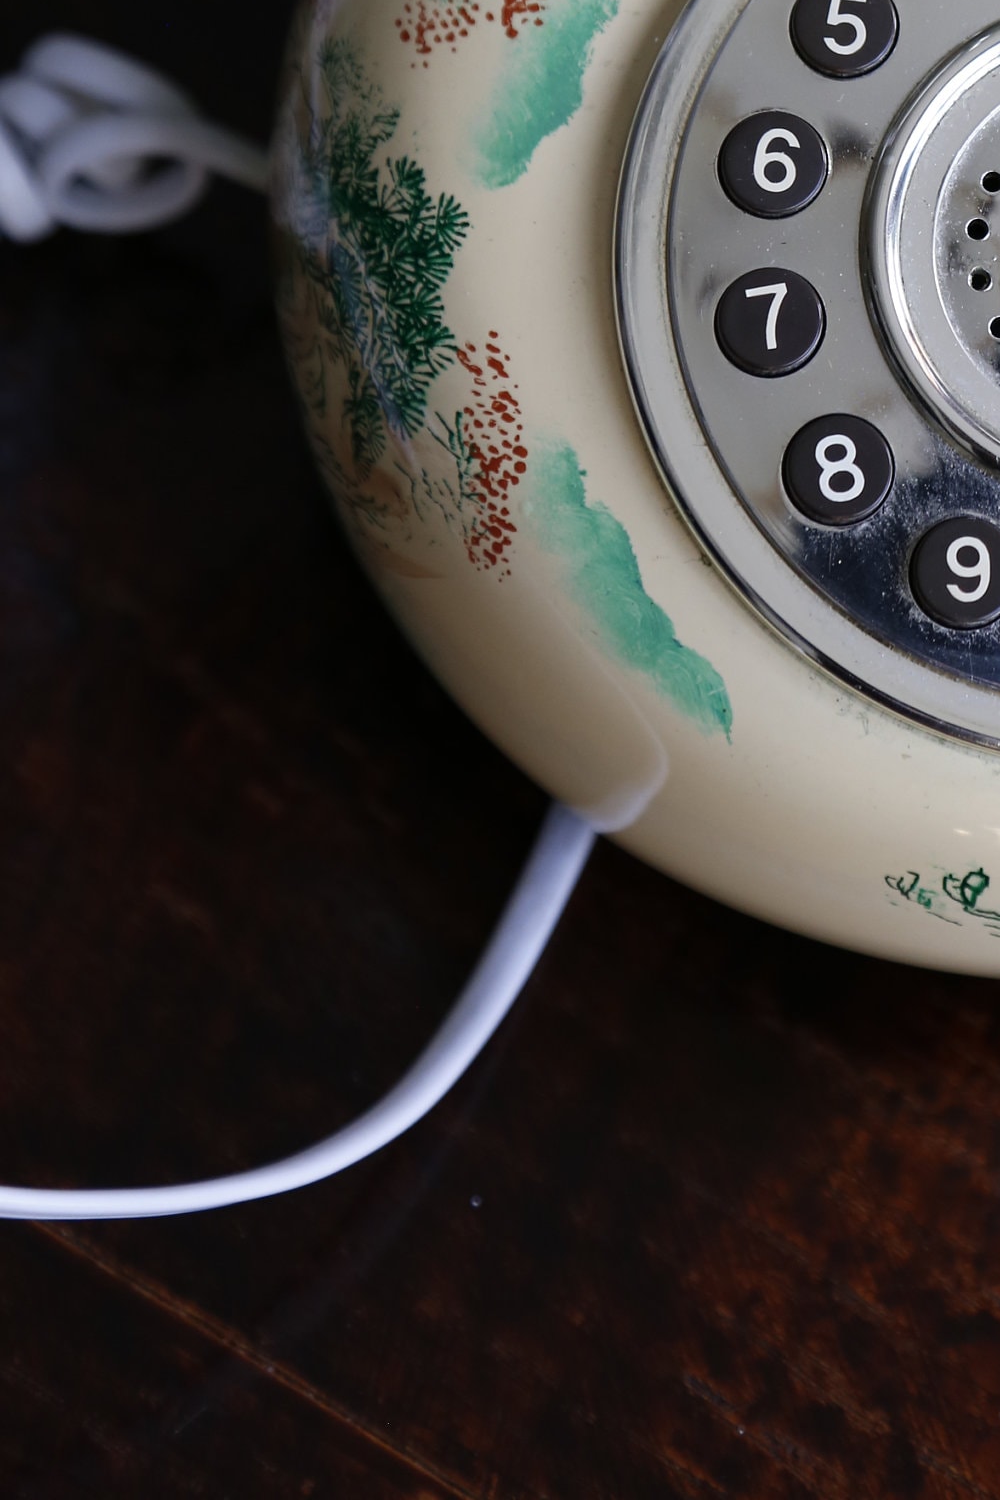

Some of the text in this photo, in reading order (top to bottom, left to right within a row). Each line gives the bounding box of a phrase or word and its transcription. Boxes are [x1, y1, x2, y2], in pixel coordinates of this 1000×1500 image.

[753, 128, 801, 193] 6
[744, 282, 788, 350] 7
[814, 434, 865, 503] 8
[946, 536, 991, 603] 9
